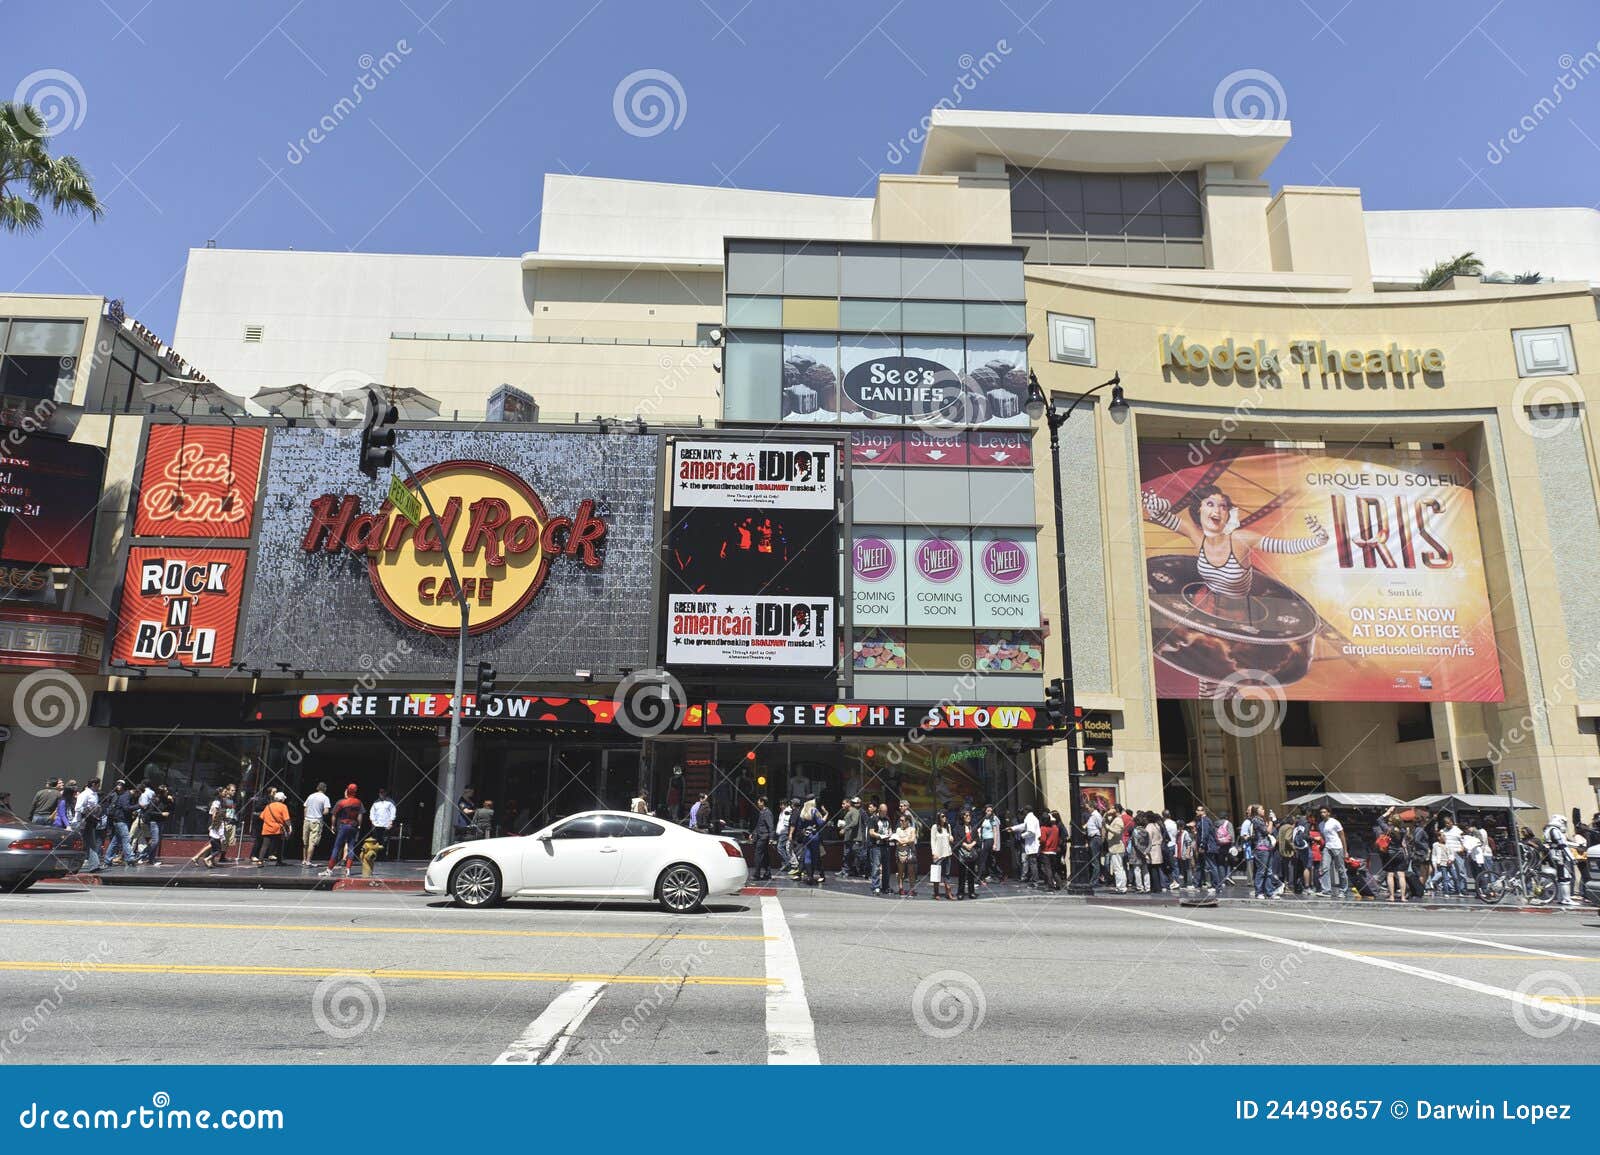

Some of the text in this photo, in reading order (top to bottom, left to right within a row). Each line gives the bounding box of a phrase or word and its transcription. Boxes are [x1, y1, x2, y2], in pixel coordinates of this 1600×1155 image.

[1159, 334, 1447, 375] Kodak Theatre
[870, 362, 936, 385] See's
[860, 387, 944, 401] CANDIES
[851, 432, 1022, 449] Shop Street Level
[680, 448, 722, 460] GREEN DAY'S
[680, 461, 756, 480] american
[759, 450, 831, 482] IDIOT
[1306, 472, 1464, 489] CIRQUE DU SOLEIL
[144, 482, 246, 523] Drink
[301, 493, 608, 567] Hard Rock
[1330, 494, 1454, 569] IRIS
[857, 545, 888, 572] SWEET!
[924, 546, 954, 573] SWEET!
[990, 547, 1020, 575] SWEET!
[141, 558, 232, 596] ROCK
[418, 576, 494, 602] CAFE
[852, 591, 896, 602] COMING
[916, 592, 963, 603] COMING
[984, 593, 1030, 604] COMING
[674, 602, 717, 614] GREEN DAY'S
[856, 604, 889, 615] SOON
[923, 605, 957, 616] SOON
[991, 606, 1024, 617] SOON
[1351, 607, 1456, 622] ON SALE NOW
[673, 614, 752, 636] american
[755, 602, 829, 637] IDIOT
[132, 619, 217, 663] ROLL
[1352, 624, 1461, 639] AT BOX OFFICE
[1342, 642, 1476, 658] cirquedusoleil.com/iris
[336, 696, 377, 715] SEE
[388, 696, 437, 715] THE
[773, 705, 1022, 728] SEE THE SHOW
[1084, 720, 1112, 739] Kodak Theatre
